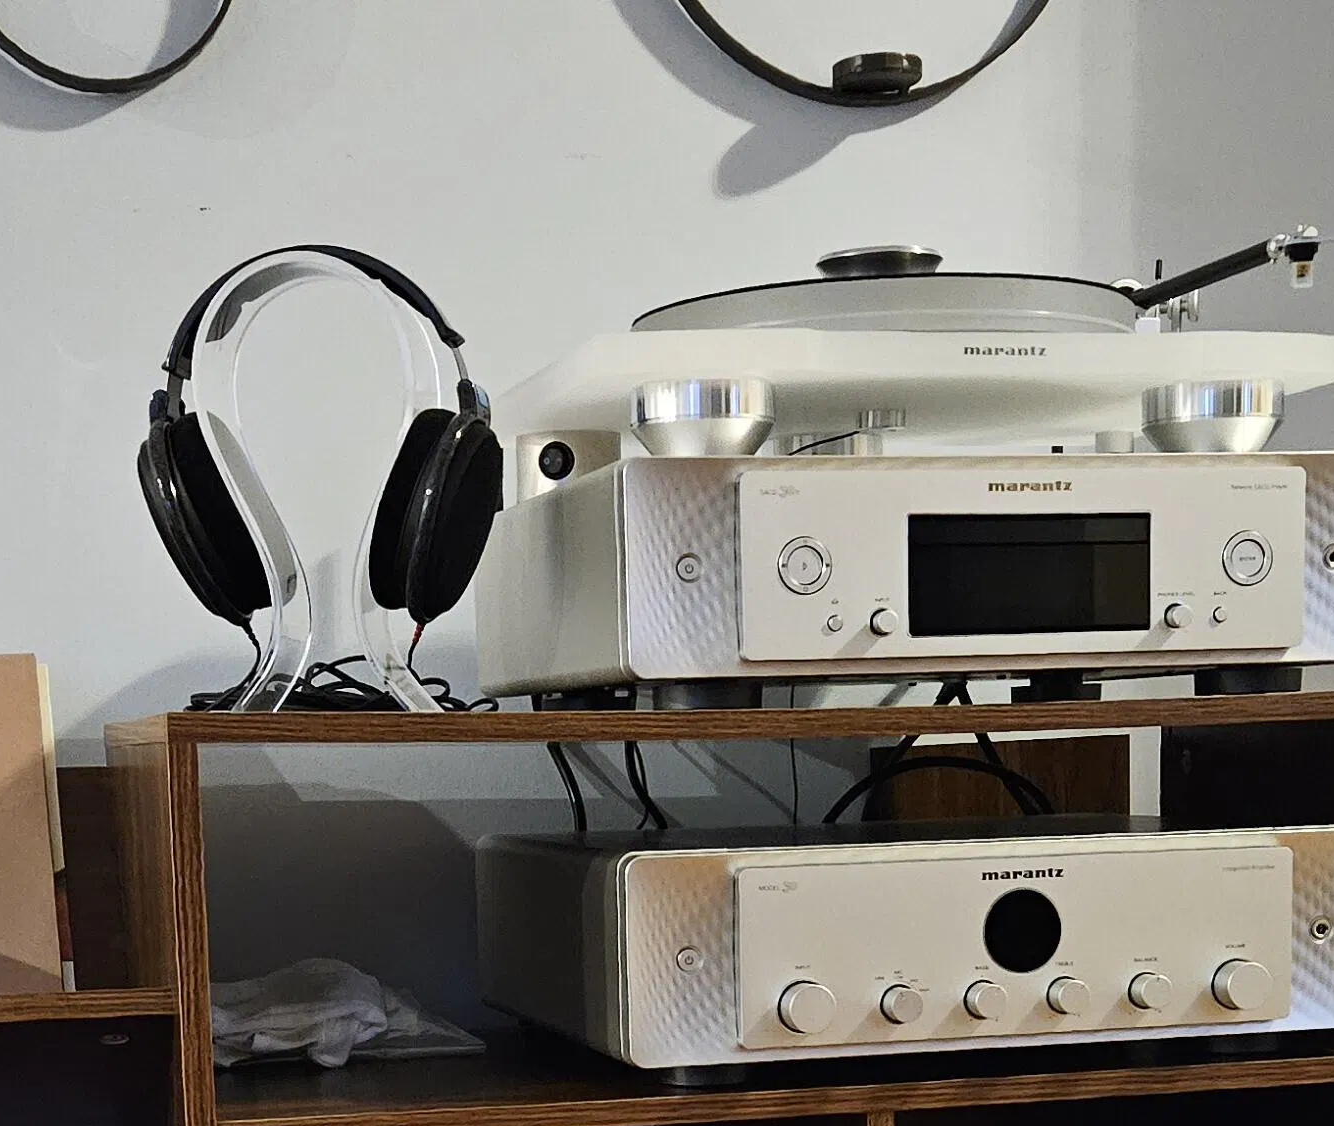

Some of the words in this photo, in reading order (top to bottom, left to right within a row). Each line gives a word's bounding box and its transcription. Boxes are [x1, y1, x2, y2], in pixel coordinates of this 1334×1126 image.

[963, 345, 1047, 357] marantz
[988, 480, 1073, 492] marantz
[981, 867, 1065, 881] marantz
